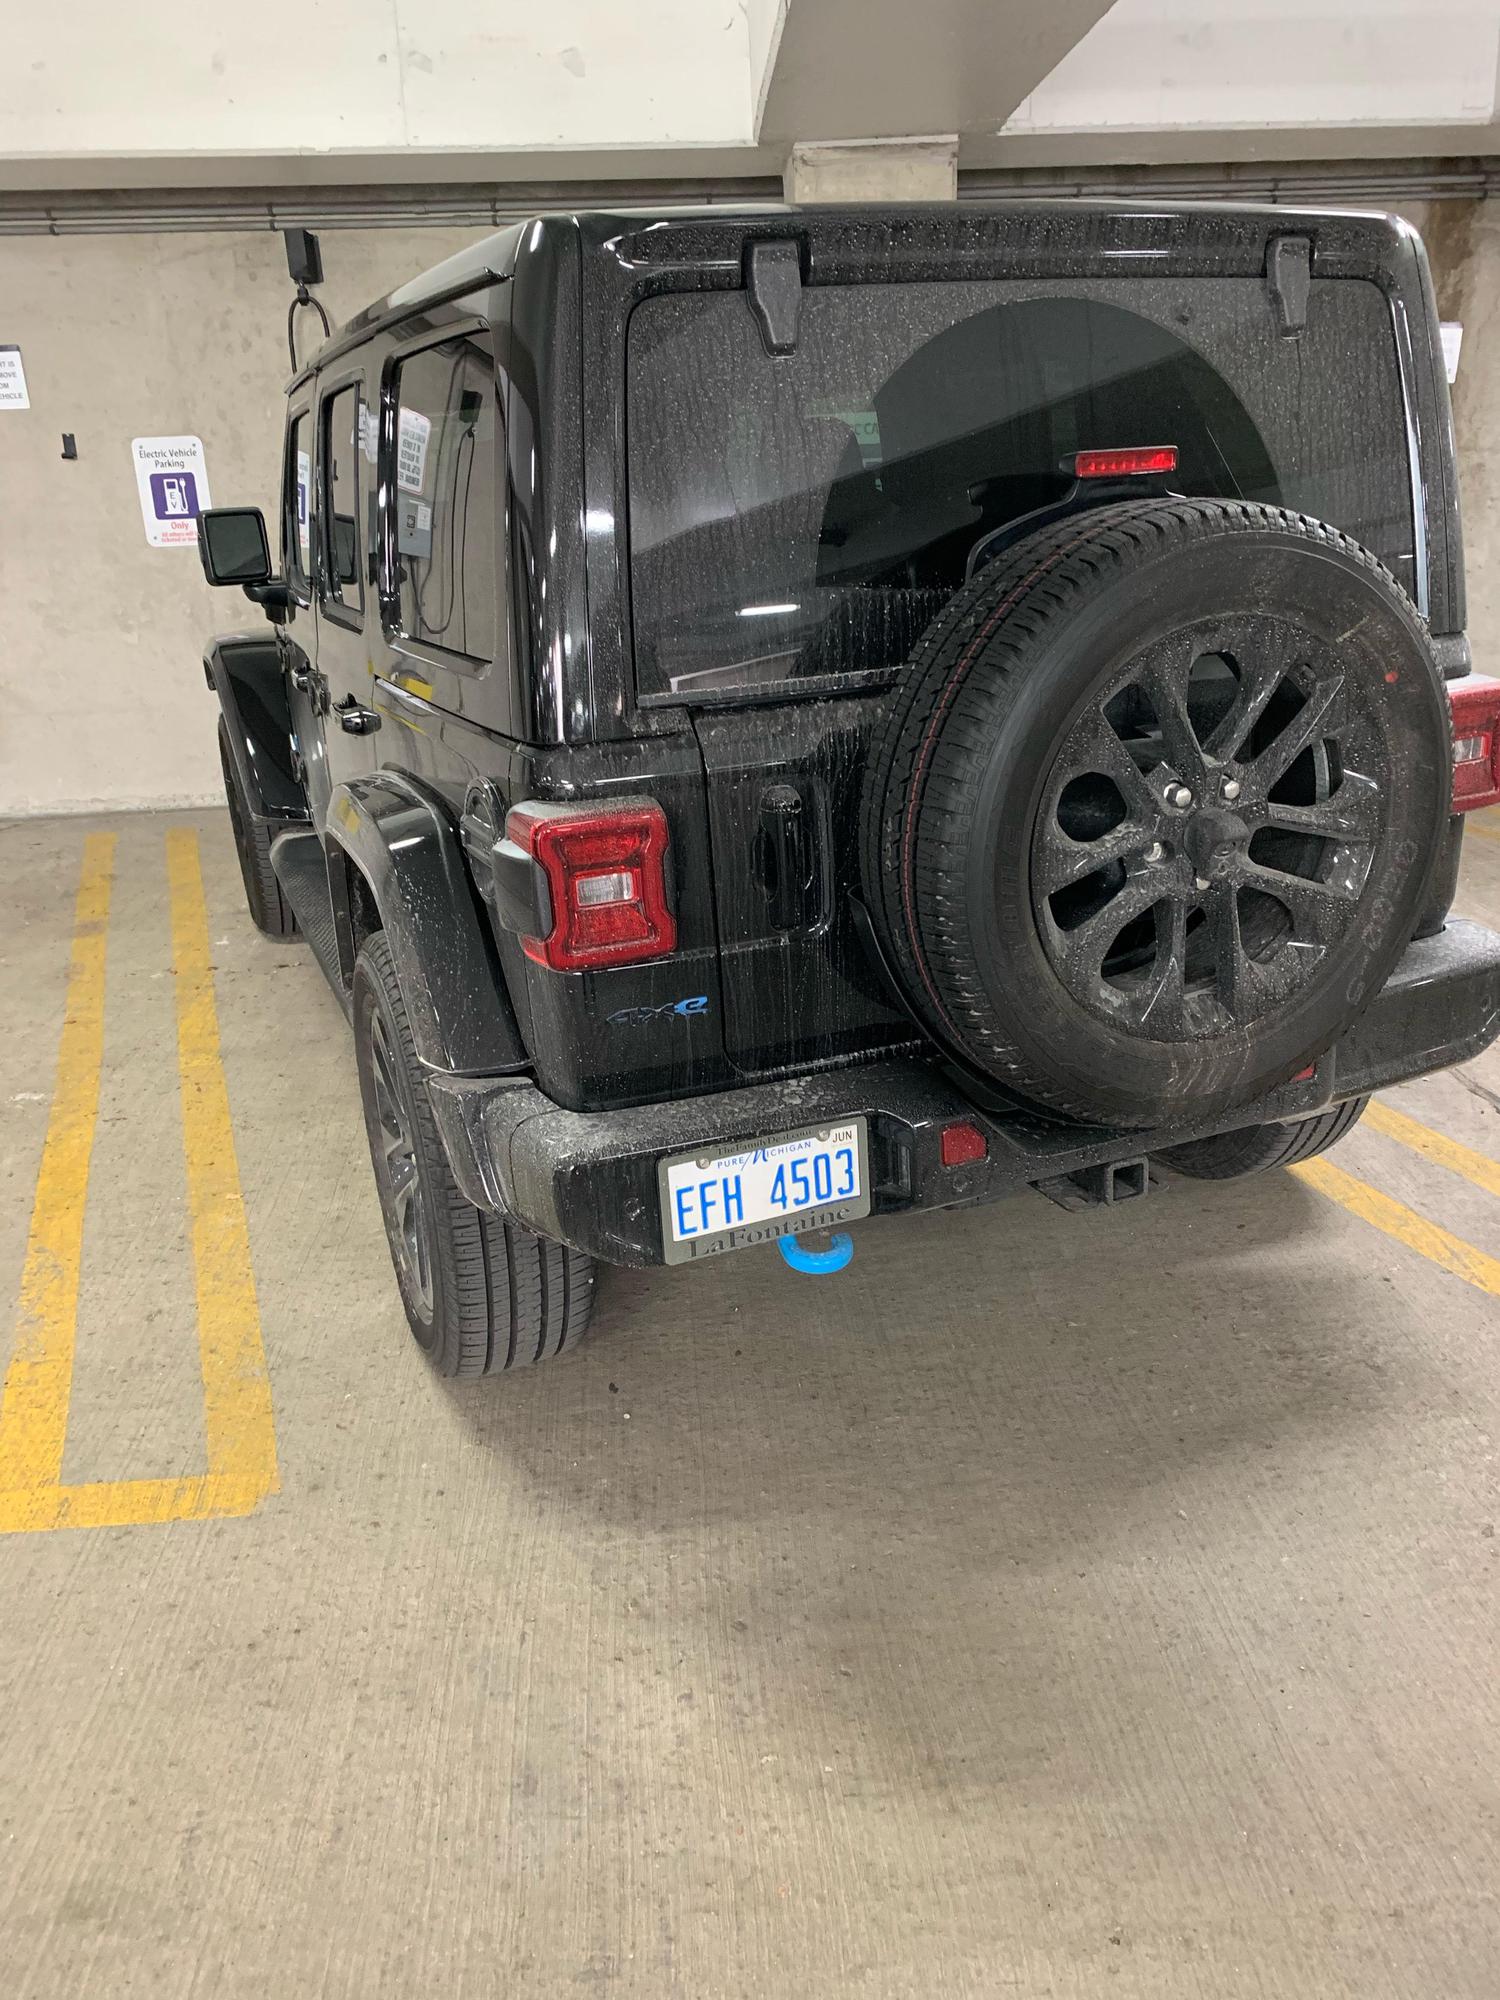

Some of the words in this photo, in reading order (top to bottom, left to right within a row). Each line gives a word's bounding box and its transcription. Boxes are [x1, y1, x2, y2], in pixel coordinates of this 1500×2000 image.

[139, 449, 168, 459] Electric
[168, 448, 198, 458] Vehicle
[154, 459, 185, 470] Parking
[170, 521, 190, 531] Only
[832, 1130, 853, 1143] JUN
[717, 1156, 744, 1169] PURE
[675, 1174, 744, 1236] EFH
[770, 1148, 854, 1210] 4503
[688, 1207, 850, 1258] LaFontaine
